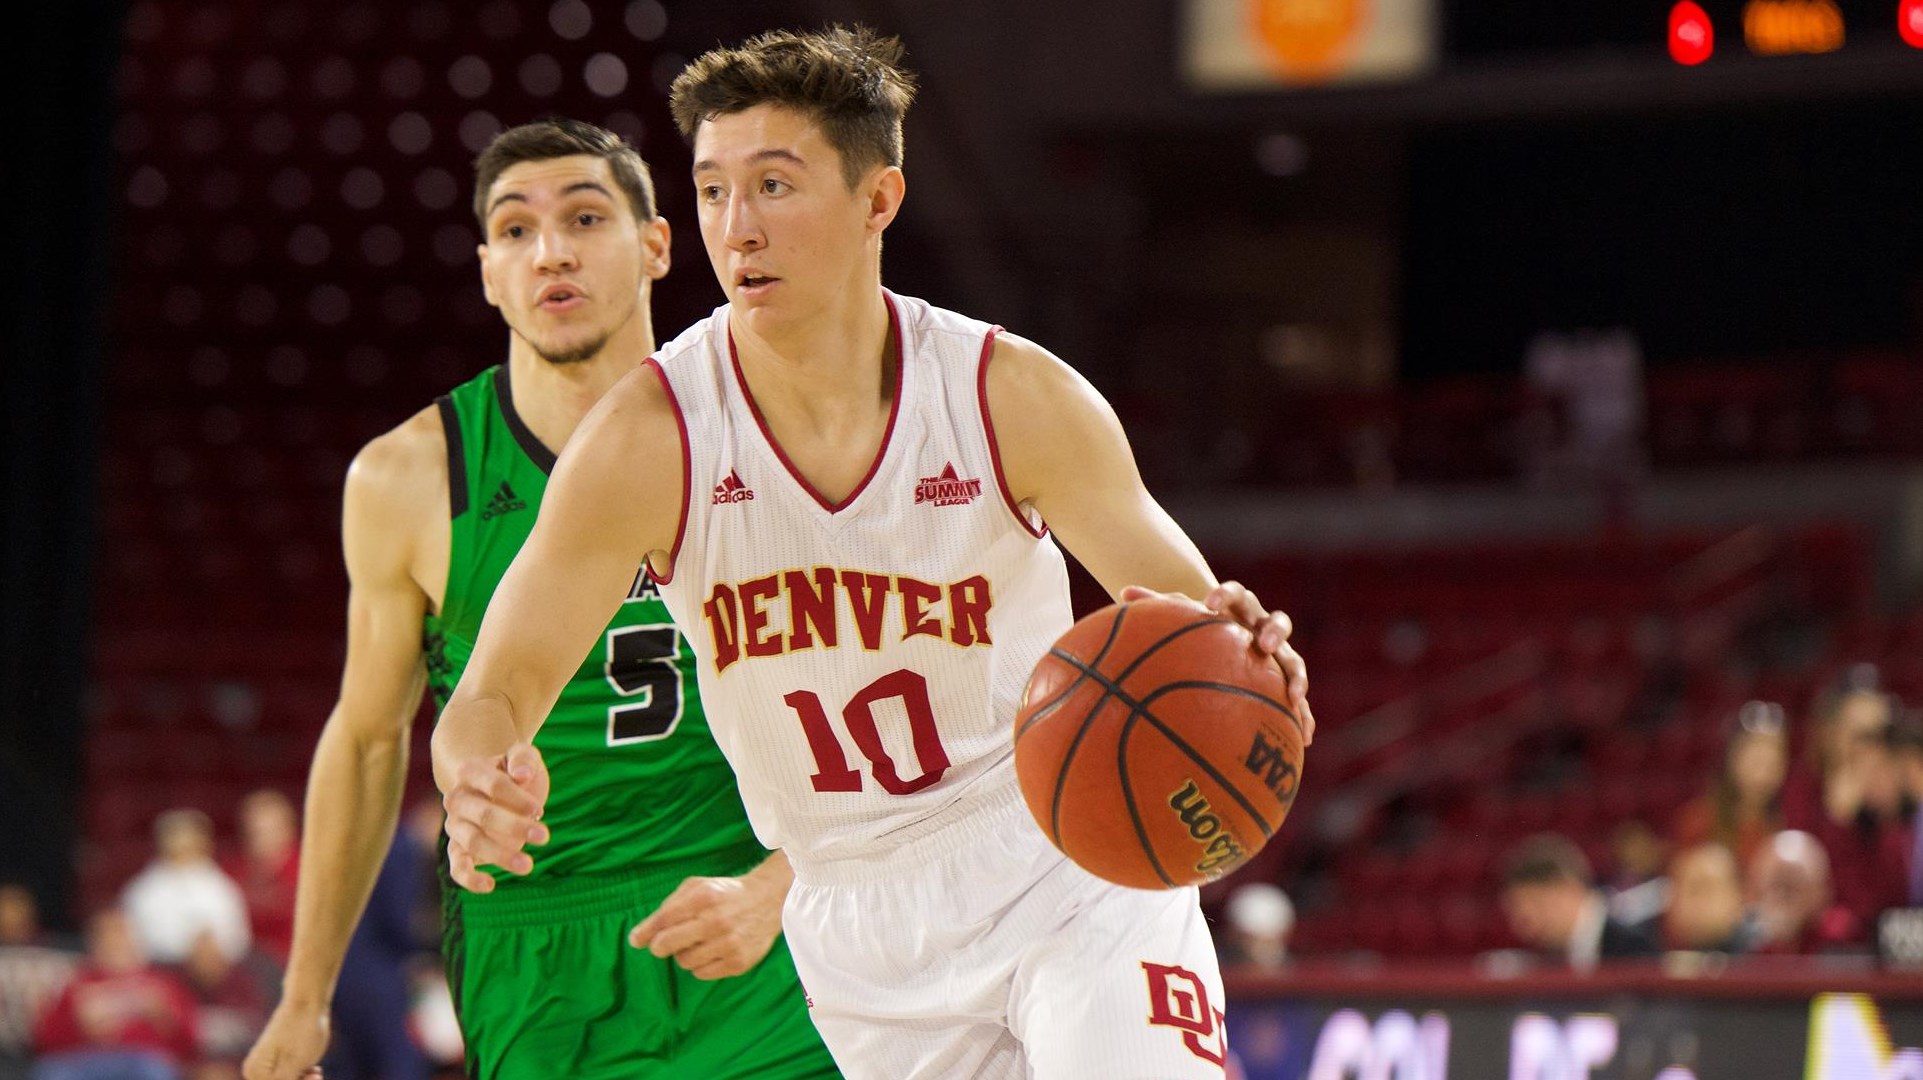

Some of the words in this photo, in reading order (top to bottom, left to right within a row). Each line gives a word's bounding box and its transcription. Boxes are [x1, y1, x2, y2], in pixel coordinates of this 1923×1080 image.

[914, 478, 982, 505] SUMMIT
[703, 565, 993, 678] DENVER
[605, 623, 684, 747] 5
[783, 668, 952, 795] 10
[1245, 730, 1298, 803] CAA
